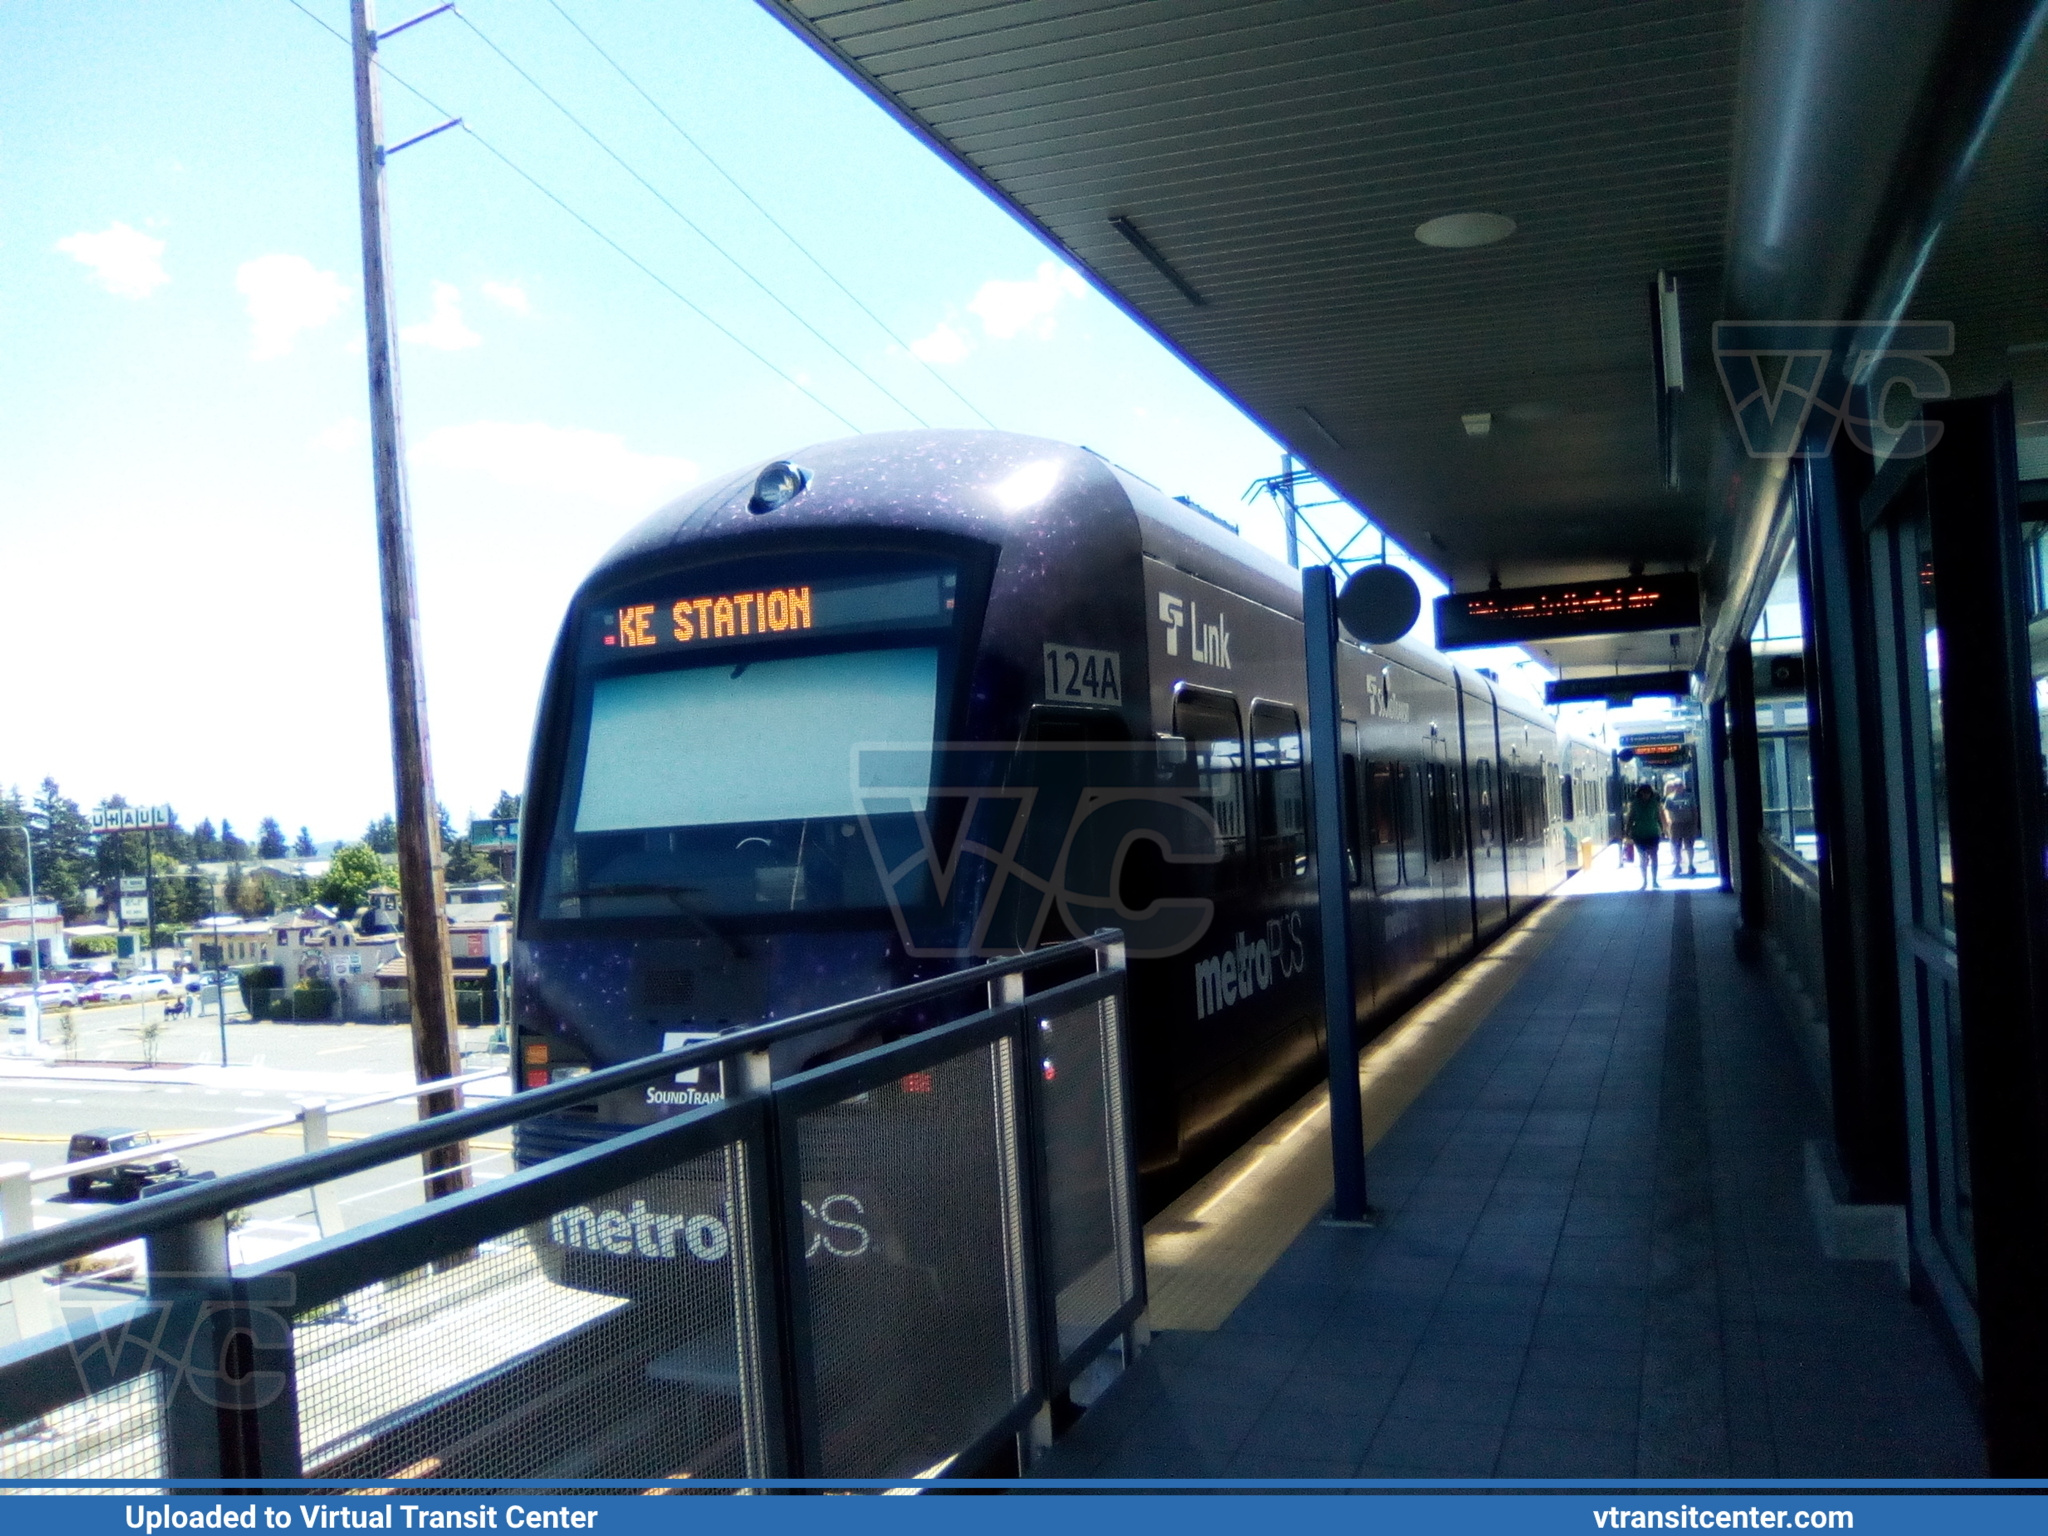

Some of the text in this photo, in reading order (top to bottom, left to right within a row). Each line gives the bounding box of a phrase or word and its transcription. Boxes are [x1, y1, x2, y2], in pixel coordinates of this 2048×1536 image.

[619, 586, 812, 648] KE STATION
[1190, 600, 1232, 670] Link
[1047, 649, 1120, 701] 124A
[1194, 910, 1305, 1021] metroPCS
